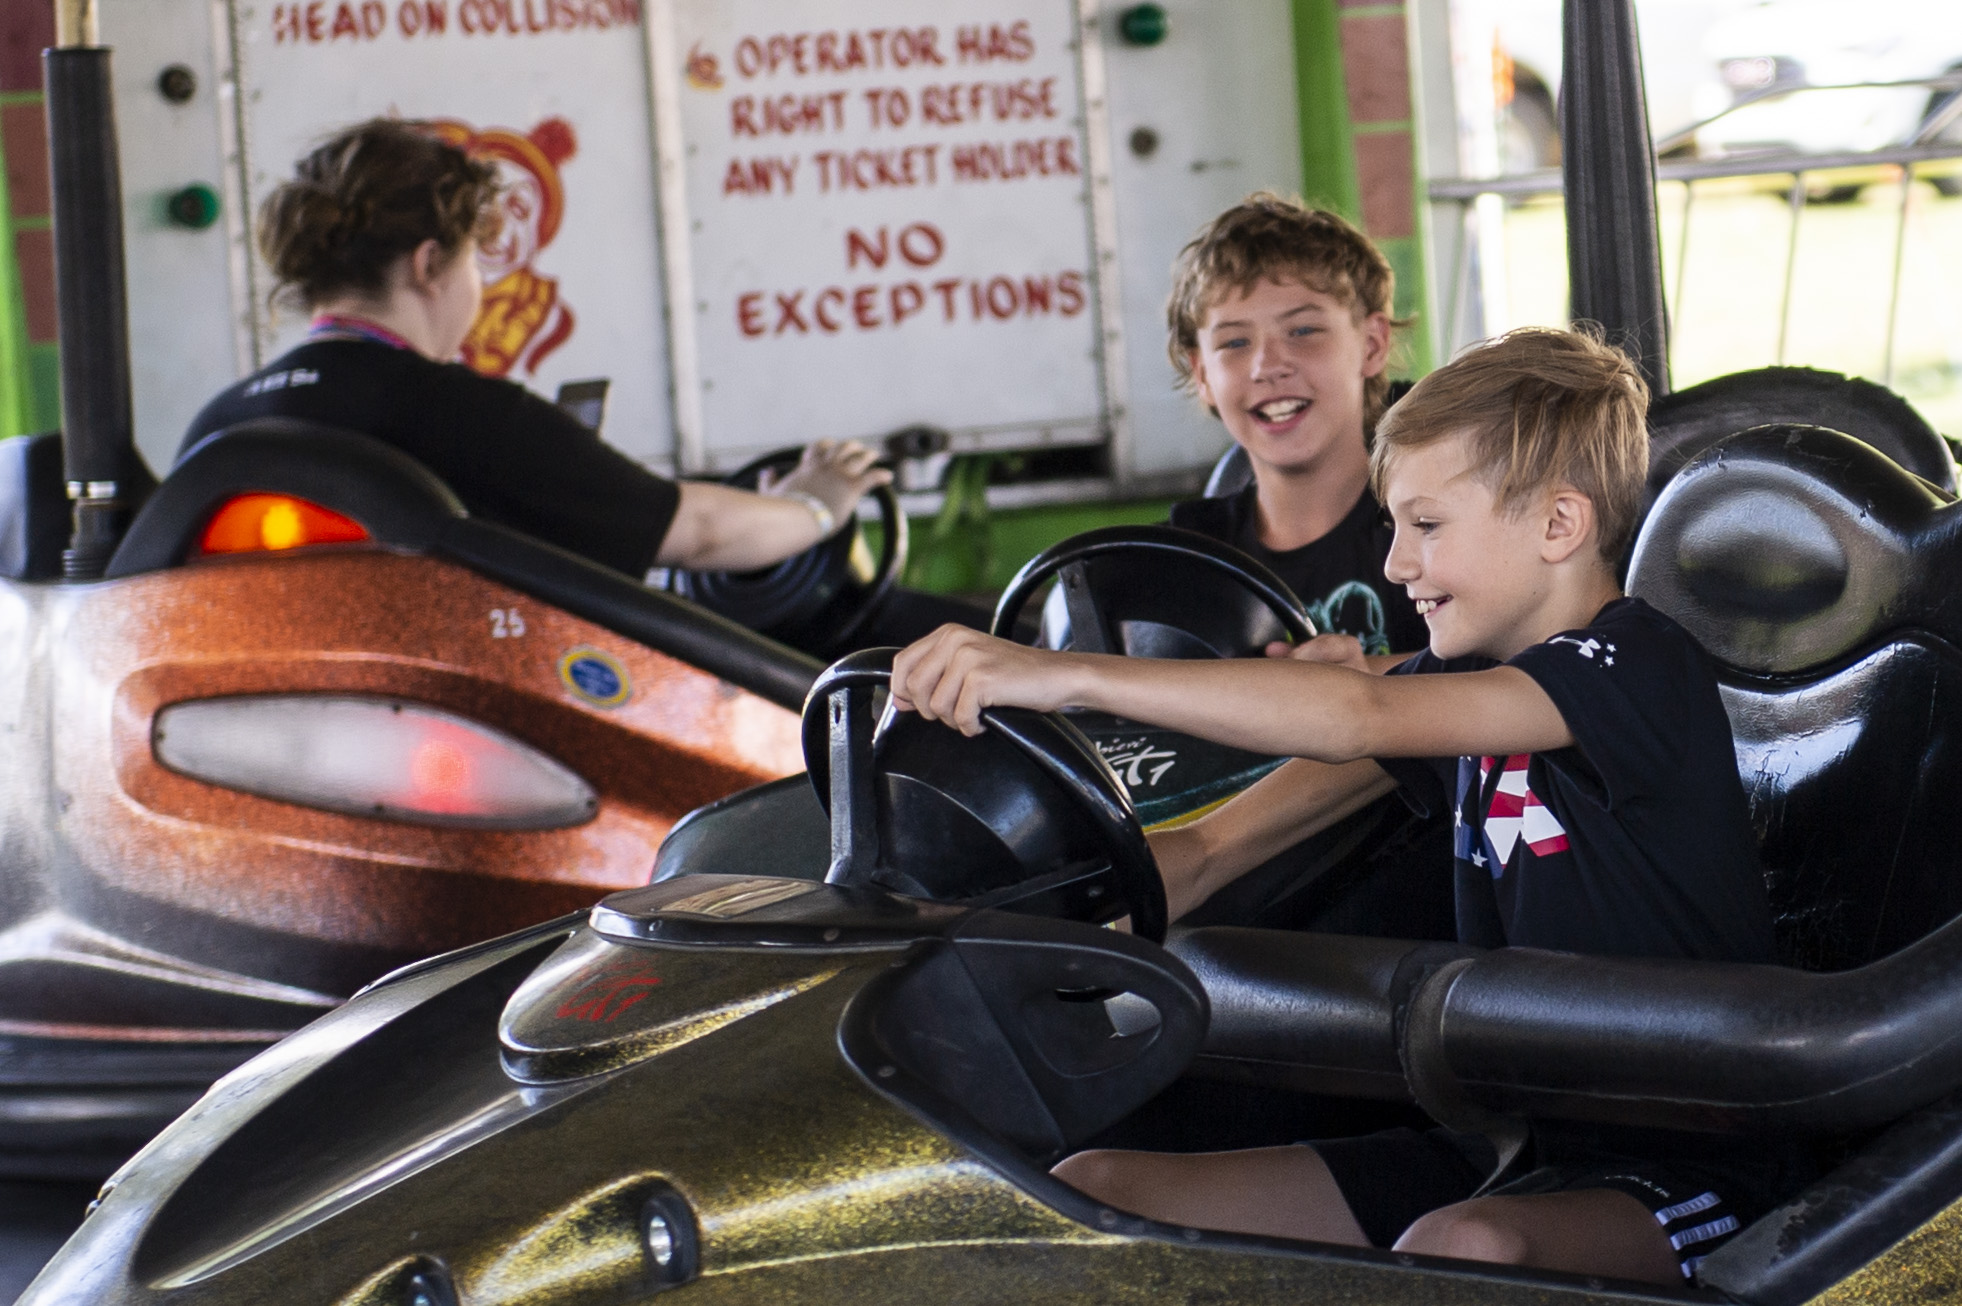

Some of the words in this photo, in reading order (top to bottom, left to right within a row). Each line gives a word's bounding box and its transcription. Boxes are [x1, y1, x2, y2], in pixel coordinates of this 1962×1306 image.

[271, 0, 386, 44] HEAD
[398, 0, 447, 38] ON
[458, 0, 639, 35] COLLISION
[734, 25, 946, 80] OPERATOR
[956, 19, 1035, 64] HAS
[730, 89, 847, 138] RIGHT
[864, 87, 910, 131] TO
[920, 76, 1057, 126] REFUSE
[723, 155, 797, 198] ANY
[813, 143, 939, 194] TICKET
[951, 135, 1080, 182] HOLDER
[845, 222, 945, 271] NO
[736, 269, 1087, 339] EXCEPTIONS
